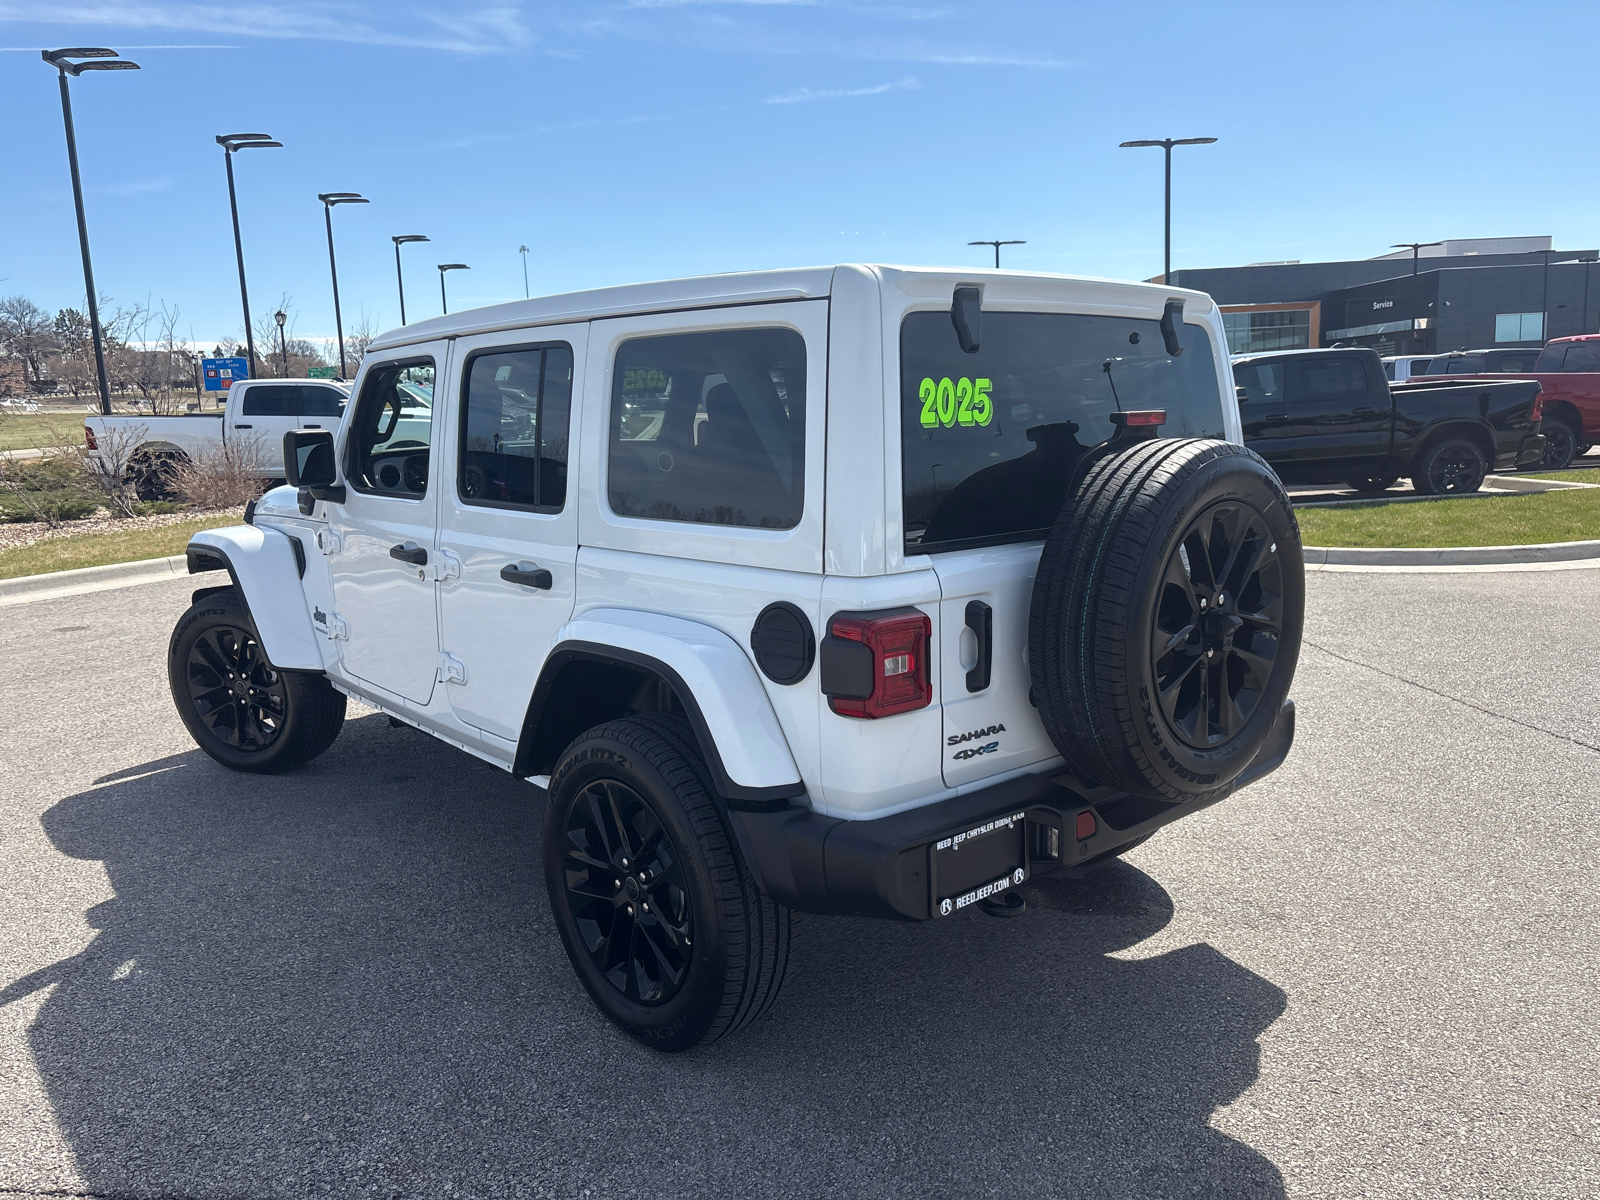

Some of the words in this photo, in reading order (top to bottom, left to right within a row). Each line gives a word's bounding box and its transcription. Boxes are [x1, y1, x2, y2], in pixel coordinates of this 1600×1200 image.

[1372, 300, 1393, 310] Service
[918, 376, 993, 429] 2025
[199, 608, 226, 618] HTX2
[1138, 686, 1163, 746] HTX2
[947, 723, 1006, 746] SAHARA
[589, 748, 628, 767] HTX2
[1158, 746, 1218, 785] ROADIAN
[936, 838, 952, 851] REED
[952, 832, 966, 845] JEEP
[967, 822, 994, 839] CHRYSLER
[994, 816, 1012, 829] DODGE
[1012, 812, 1025, 822] RAM
[956, 877, 1010, 909] REEDJEEP.COM
